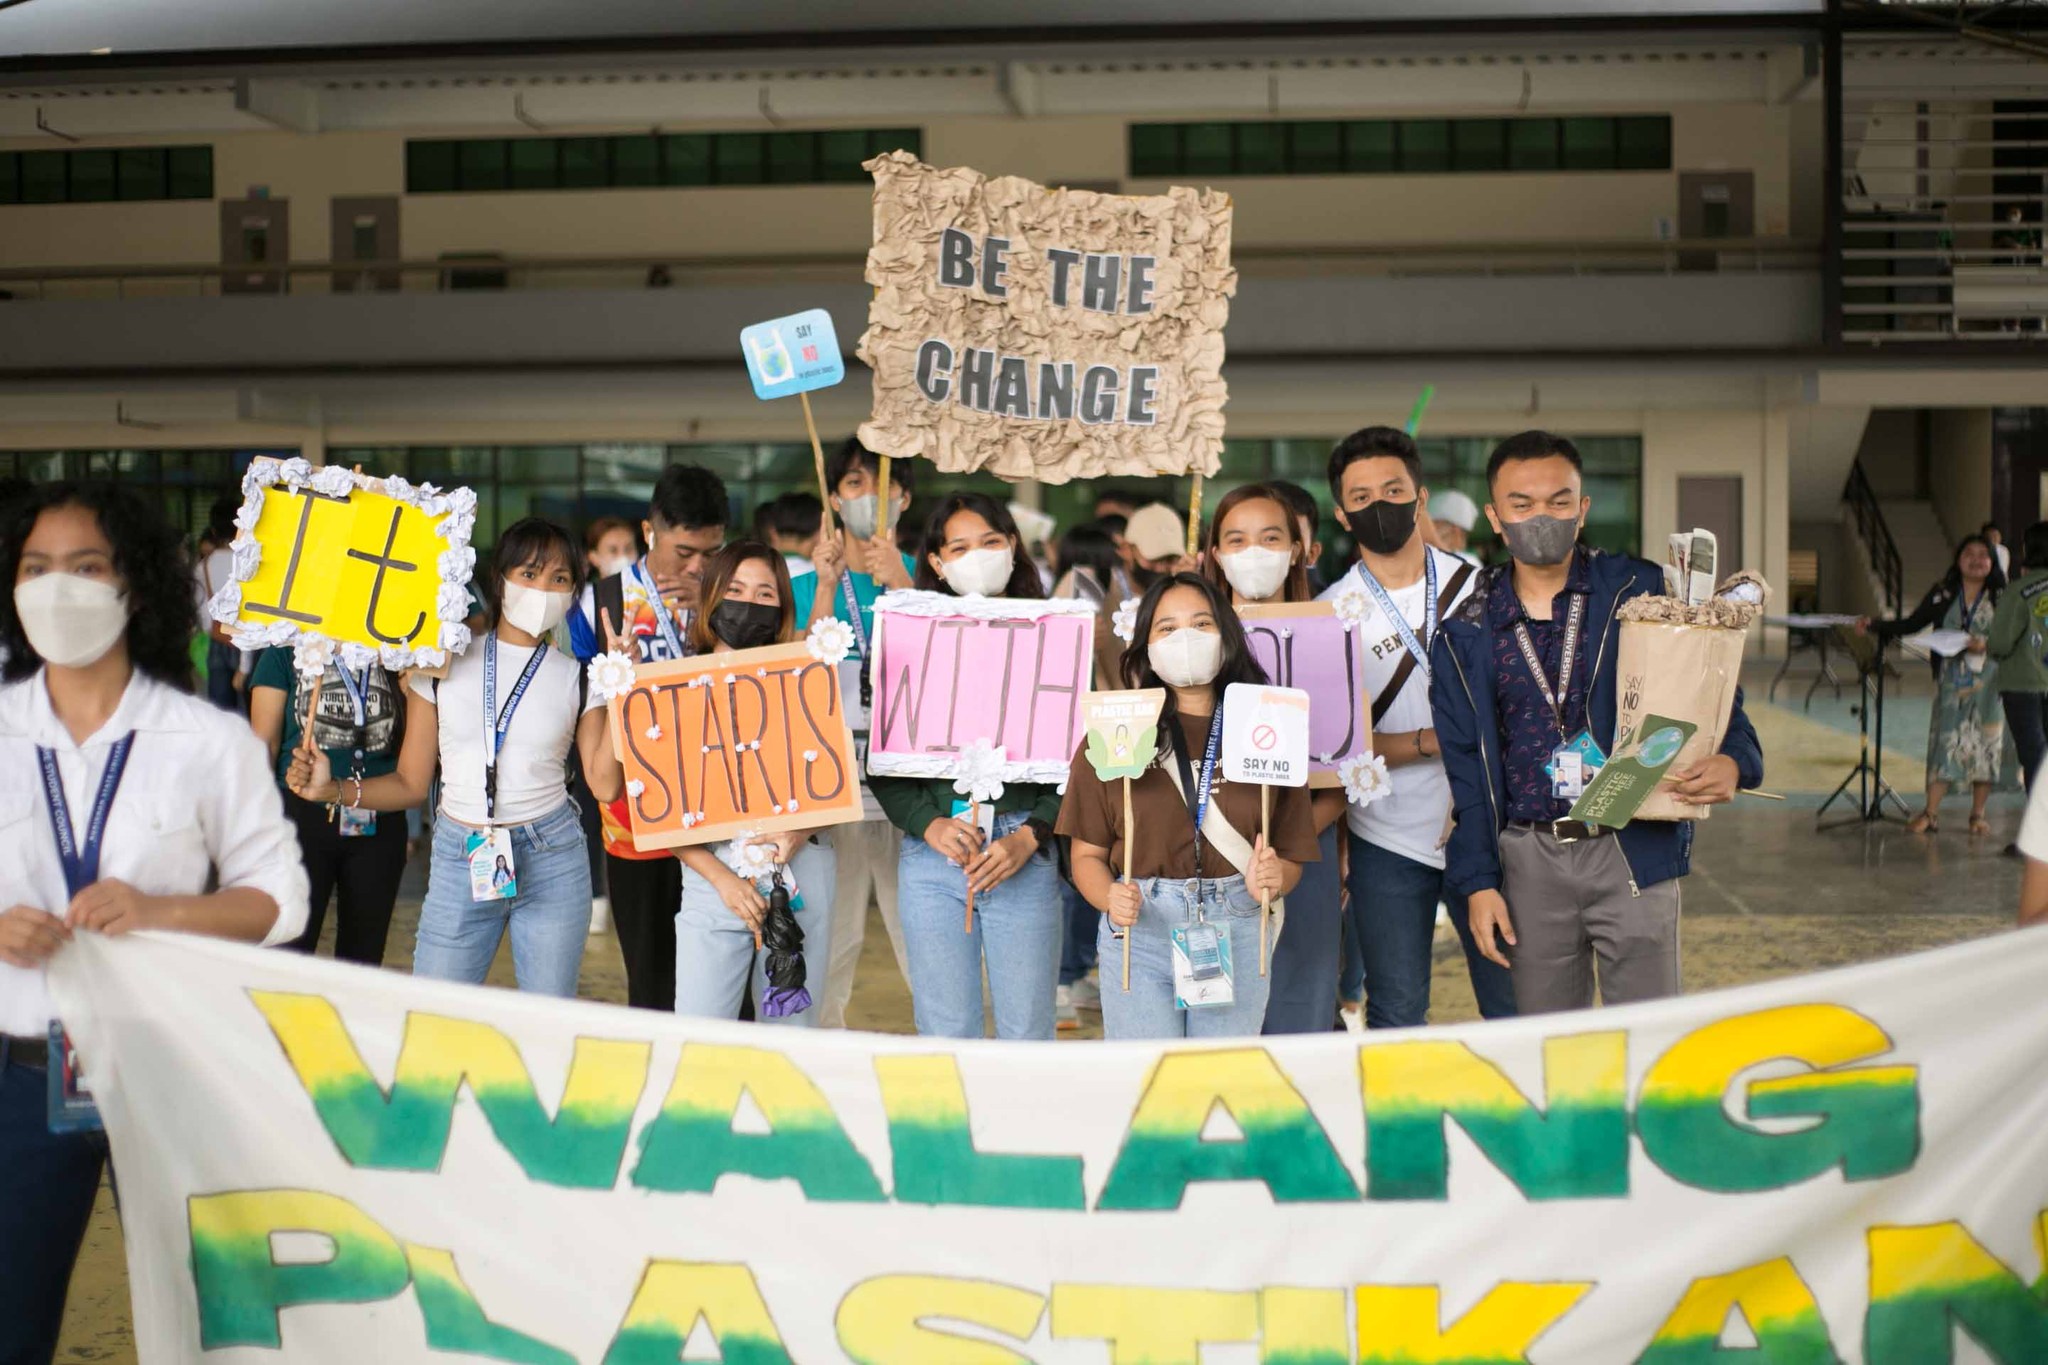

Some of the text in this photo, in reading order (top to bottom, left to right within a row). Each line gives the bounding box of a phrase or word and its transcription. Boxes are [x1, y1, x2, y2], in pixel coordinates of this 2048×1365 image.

[939, 226, 1156, 316] BE THE
[796, 324, 812, 339] SAY
[914, 338, 1160, 425] CHANGE
[245, 483, 427, 644] It
[1377, 592, 1395, 614] STATE
[1391, 613, 1421, 656] UNIVERSITY
[1561, 594, 1581, 685] STATE UNIVERSITY
[486, 664, 494, 682] STATE
[881, 618, 1083, 762] WITH
[1519, 634, 1547, 688] UNIVERSITY
[1625, 674, 1644, 691] SAY
[485, 684, 493, 728] UNIVERSITY
[498, 694, 519, 732] BUKIDNON
[514, 674, 529, 696] STATE
[1623, 692, 1639, 710] NO
[622, 661, 845, 828] STARTS
[1198, 762, 1213, 804] BUKIDNON
[1206, 735, 1218, 760] STATE
[1243, 757, 1289, 772] SAY NO
[45, 763, 63, 807] STUDENT
[55, 808, 72, 857] COUNCIL
[1586, 771, 1623, 817] PLASTIC
[1594, 773, 1632, 818] BAG FREE
[244, 987, 1921, 1212] WALANG
